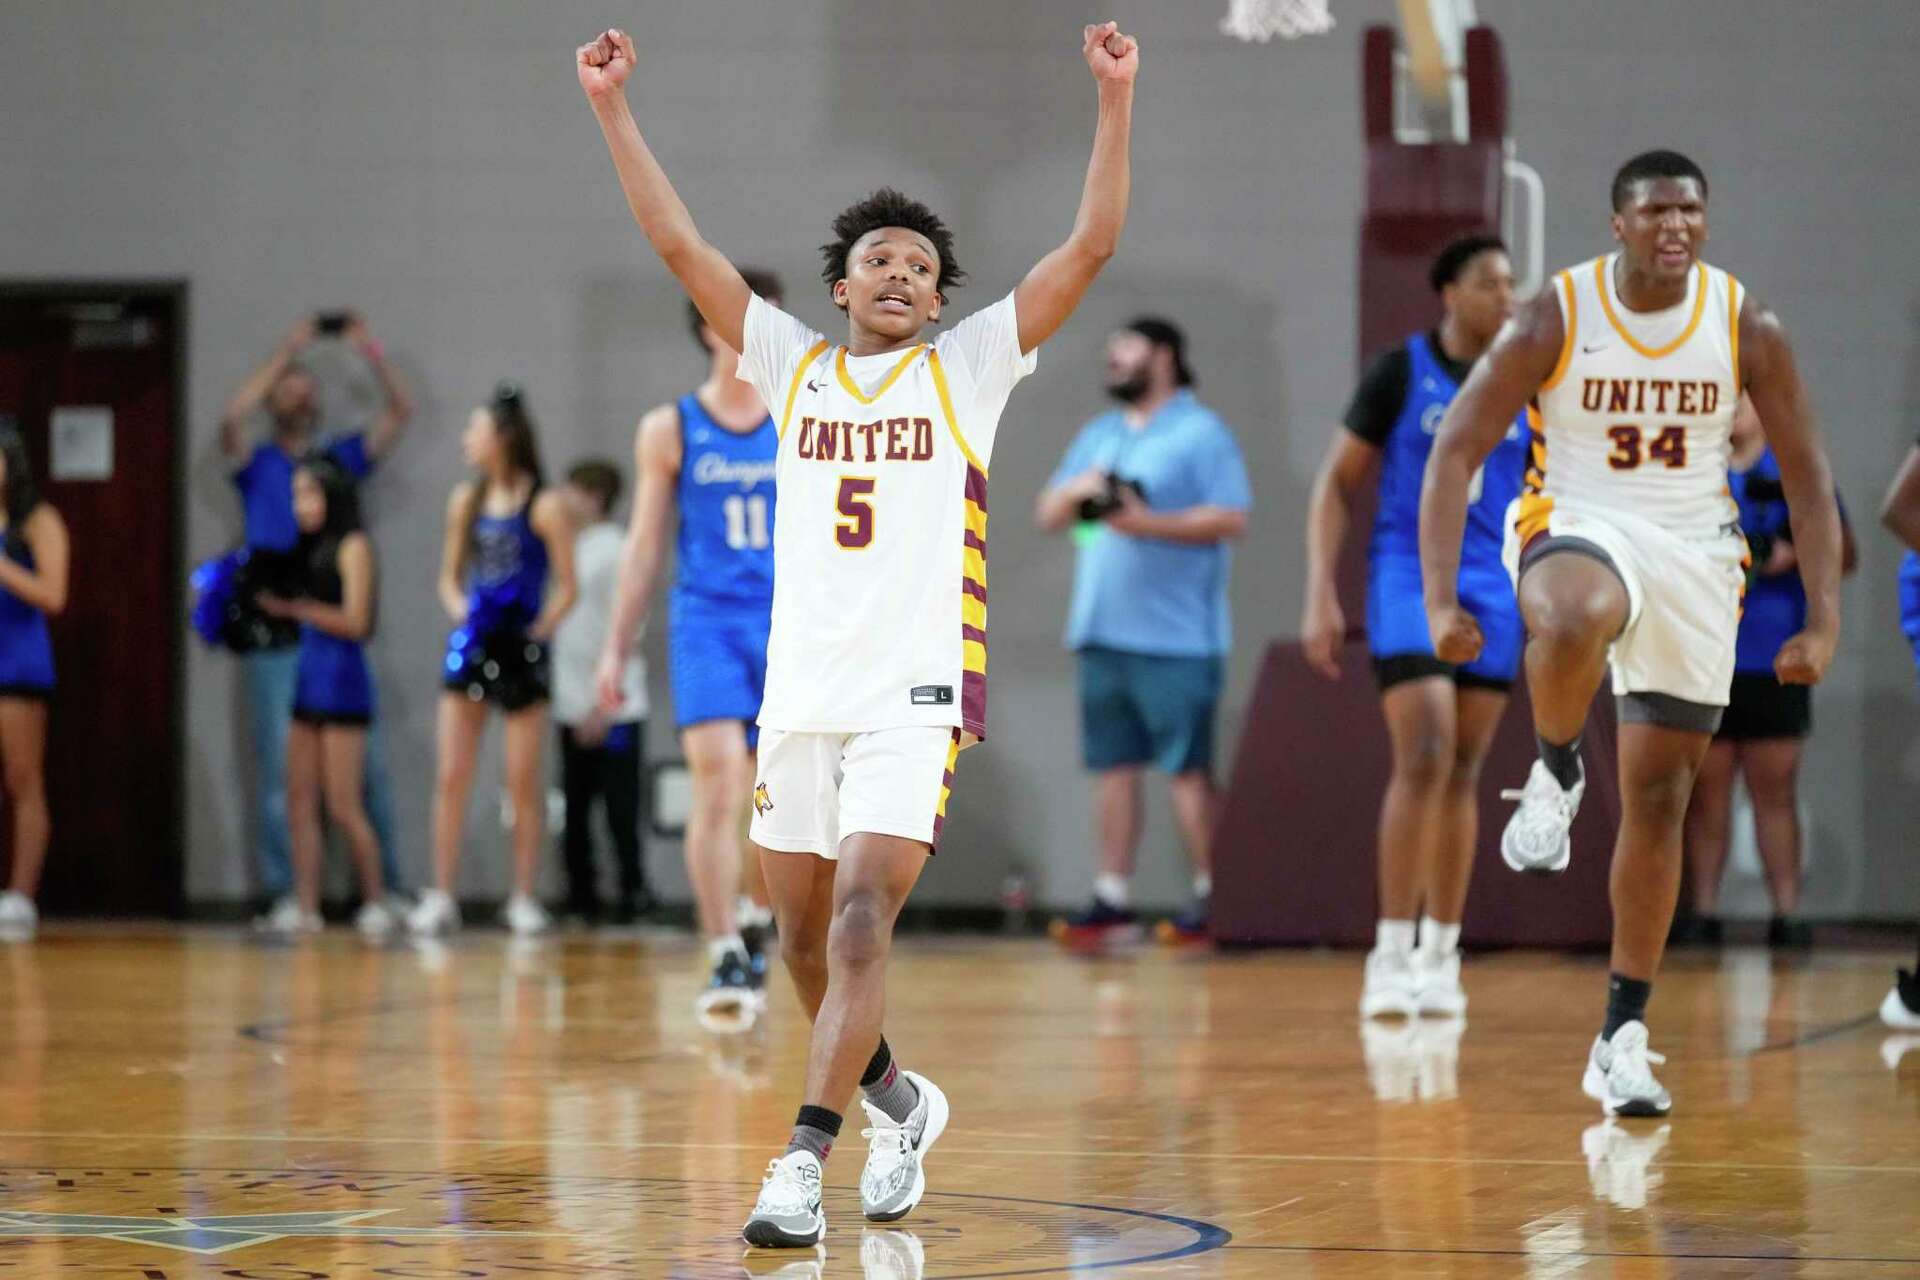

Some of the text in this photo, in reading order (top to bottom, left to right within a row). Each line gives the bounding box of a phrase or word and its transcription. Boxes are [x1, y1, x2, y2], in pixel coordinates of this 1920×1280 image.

[1581, 377, 1719, 415] UNITED
[798, 416, 934, 463] UNITED
[1606, 424, 1688, 471] 34
[724, 495, 769, 550] 11
[834, 475, 876, 551] 5
[941, 691, 947, 699] L
